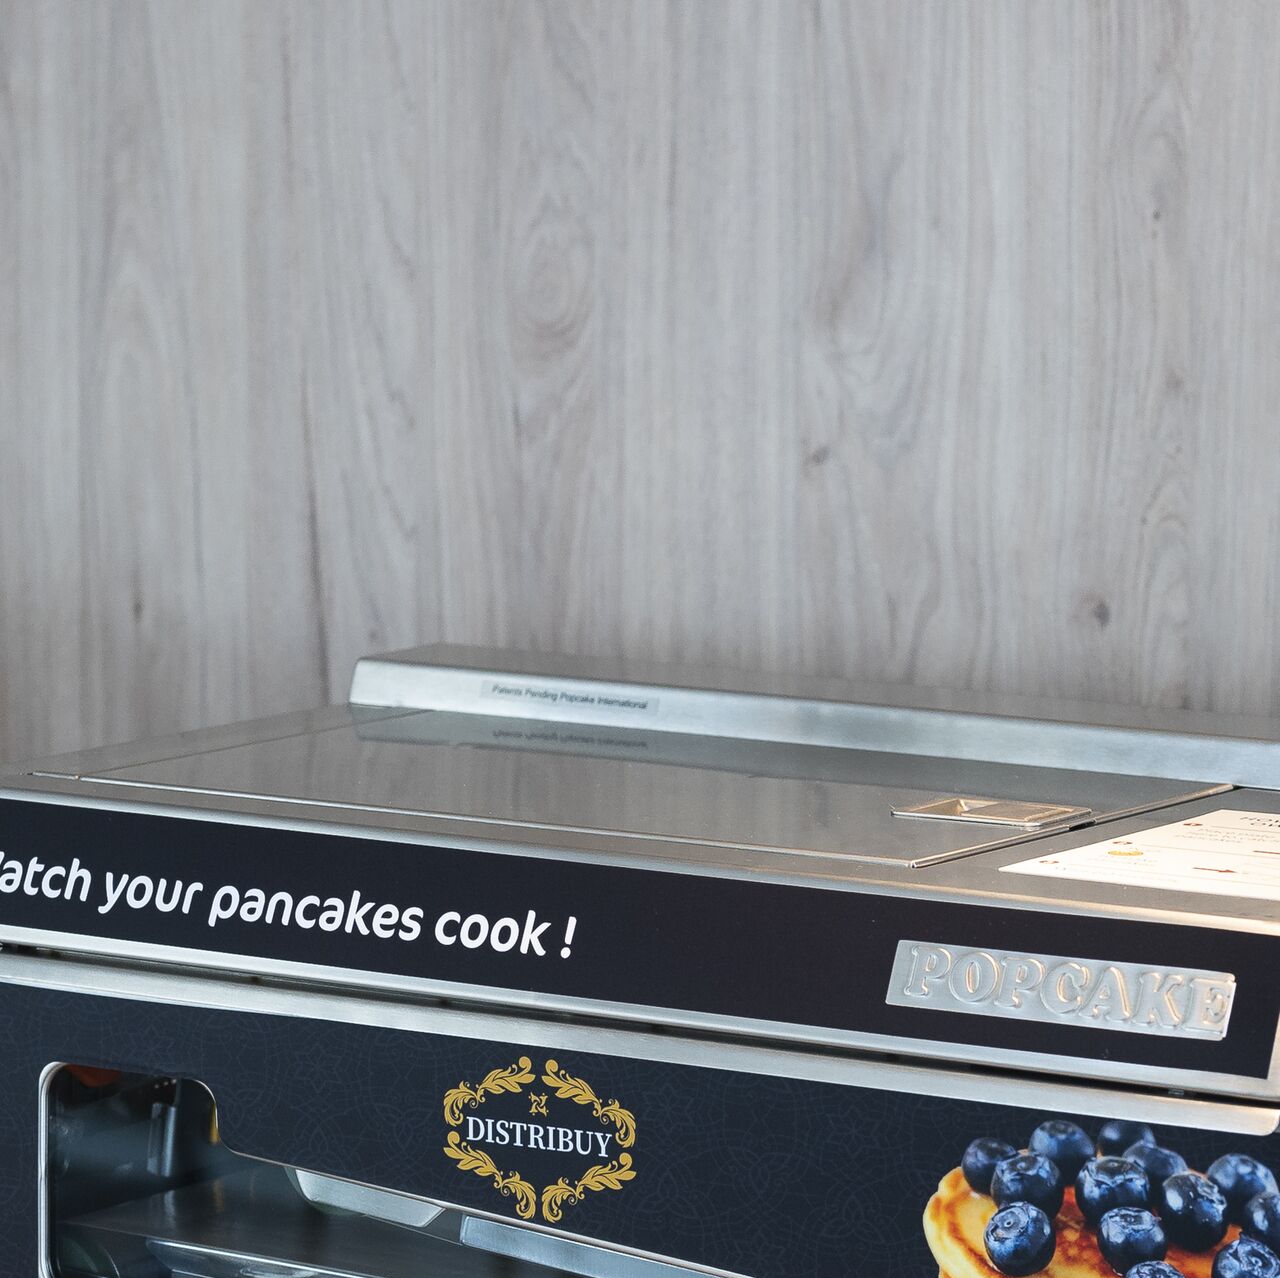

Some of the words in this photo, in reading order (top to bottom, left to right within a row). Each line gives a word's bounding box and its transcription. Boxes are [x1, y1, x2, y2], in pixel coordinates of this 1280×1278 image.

[97, 871, 204, 915] your
[207, 884, 425, 941] pancakes
[434, 908, 552, 957] cook
[903, 944, 1232, 1035] POPCAKE
[466, 1115, 613, 1158] DISTRIBUY
